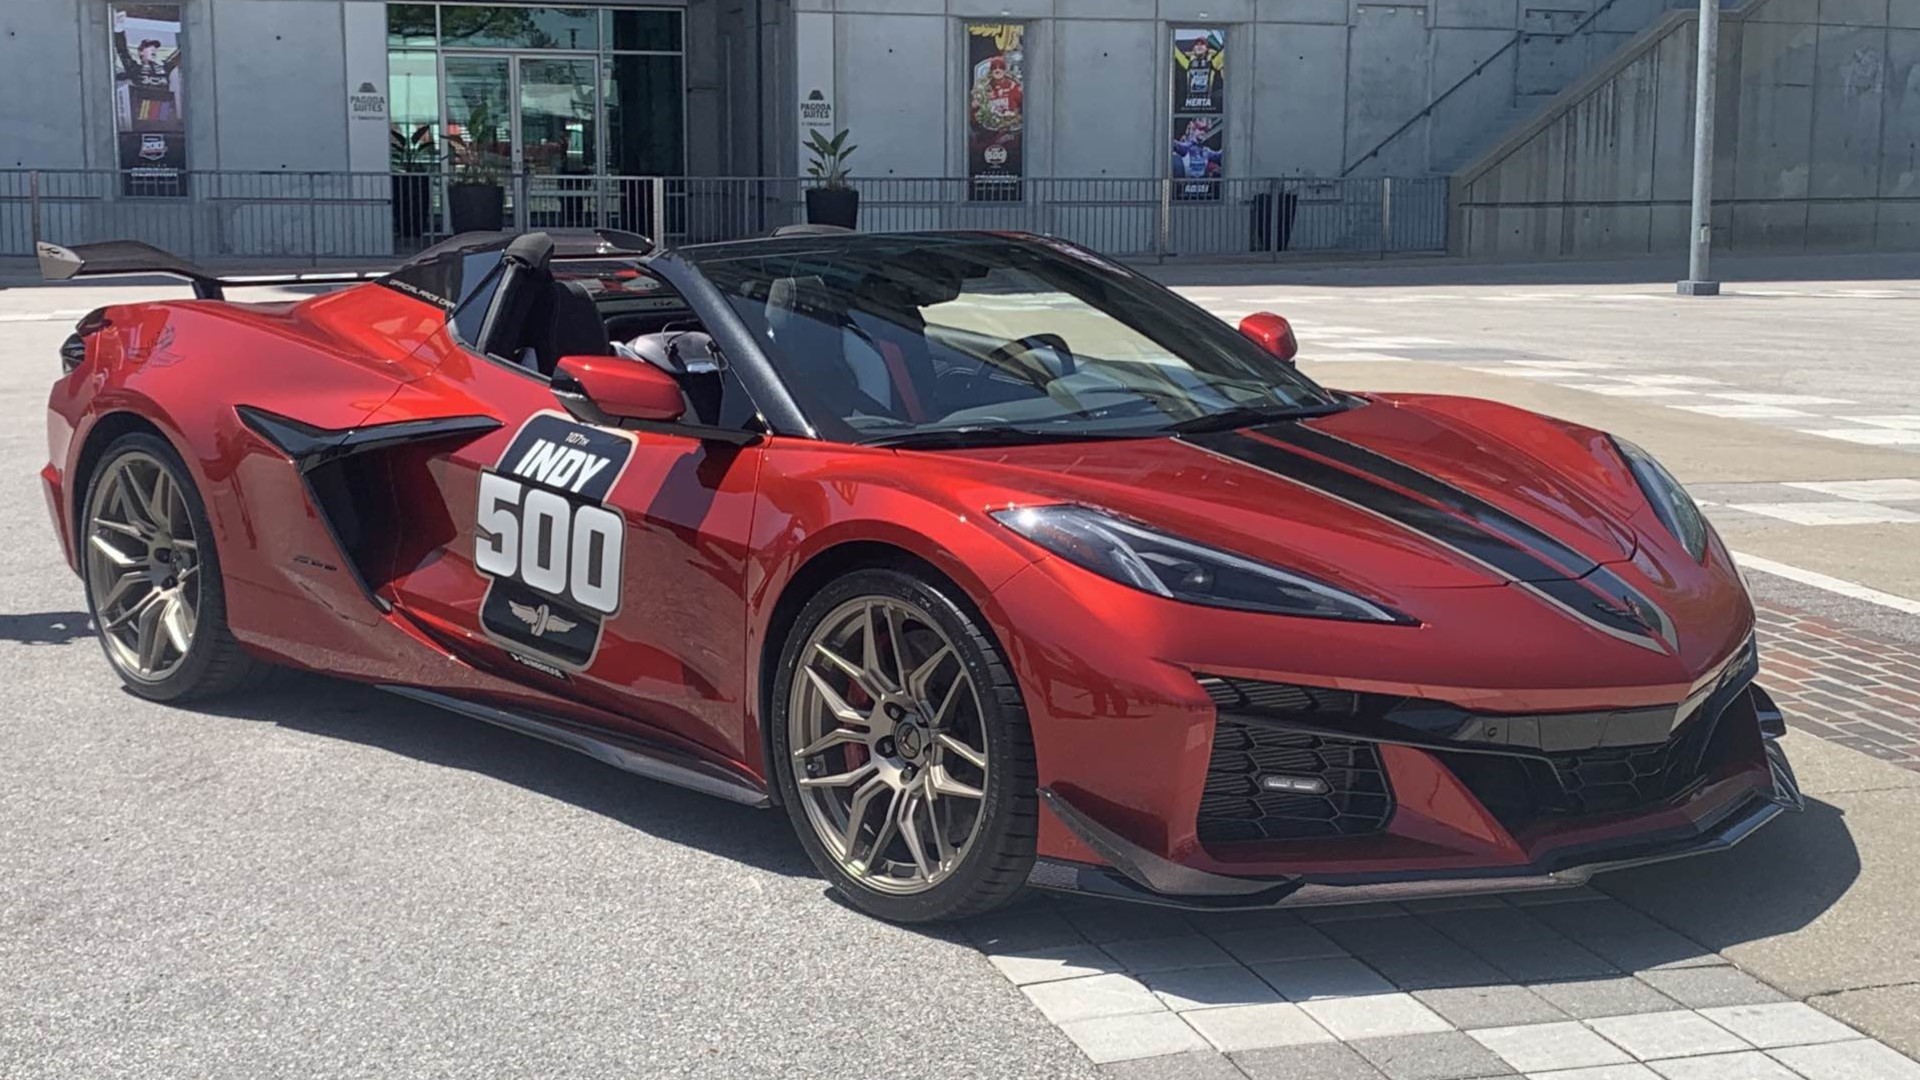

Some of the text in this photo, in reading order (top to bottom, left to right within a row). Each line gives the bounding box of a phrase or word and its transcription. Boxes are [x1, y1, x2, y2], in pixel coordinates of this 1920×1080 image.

[350, 95, 385, 104] PAGODA
[1185, 98, 1212, 107] HERTA
[353, 103, 383, 112] SUITES
[800, 102, 831, 110] PAGODA
[803, 110, 829, 118] SUITES
[438, 298, 456, 309] CAR
[513, 438, 611, 493] INDY
[475, 472, 624, 613] 500
